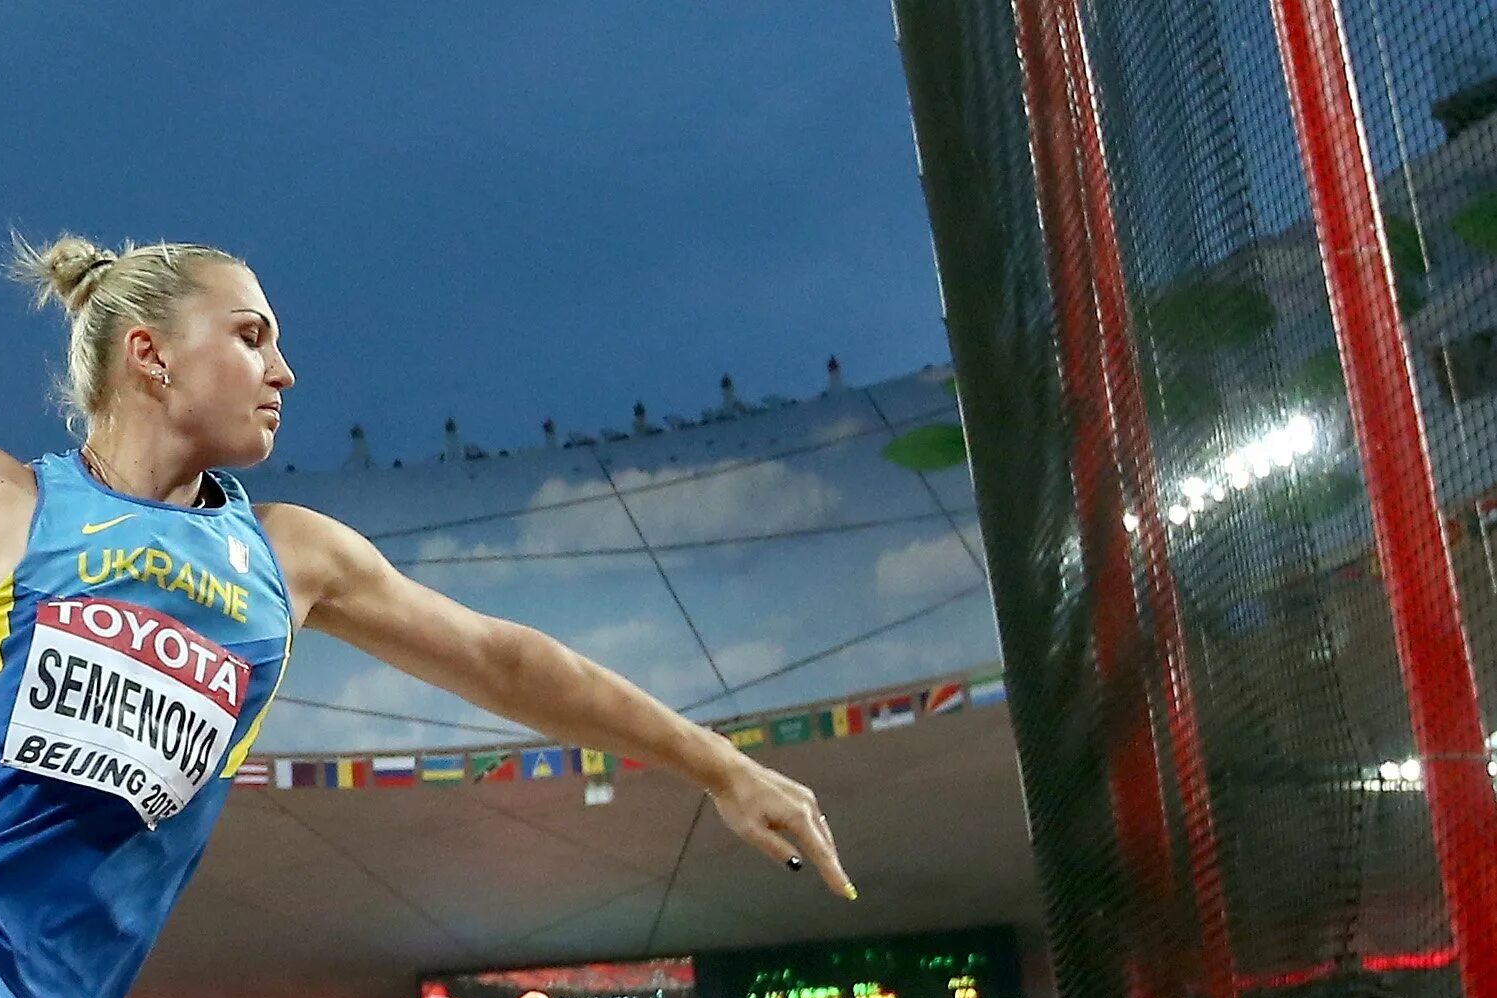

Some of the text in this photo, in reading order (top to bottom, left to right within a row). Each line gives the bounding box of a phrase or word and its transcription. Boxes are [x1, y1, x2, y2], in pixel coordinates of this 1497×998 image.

[78, 546, 249, 623] UKRAINE
[48, 600, 239, 707] TOYOTA
[29, 648, 219, 788] SEMENOVA
[15, 735, 146, 796] BEIJING
